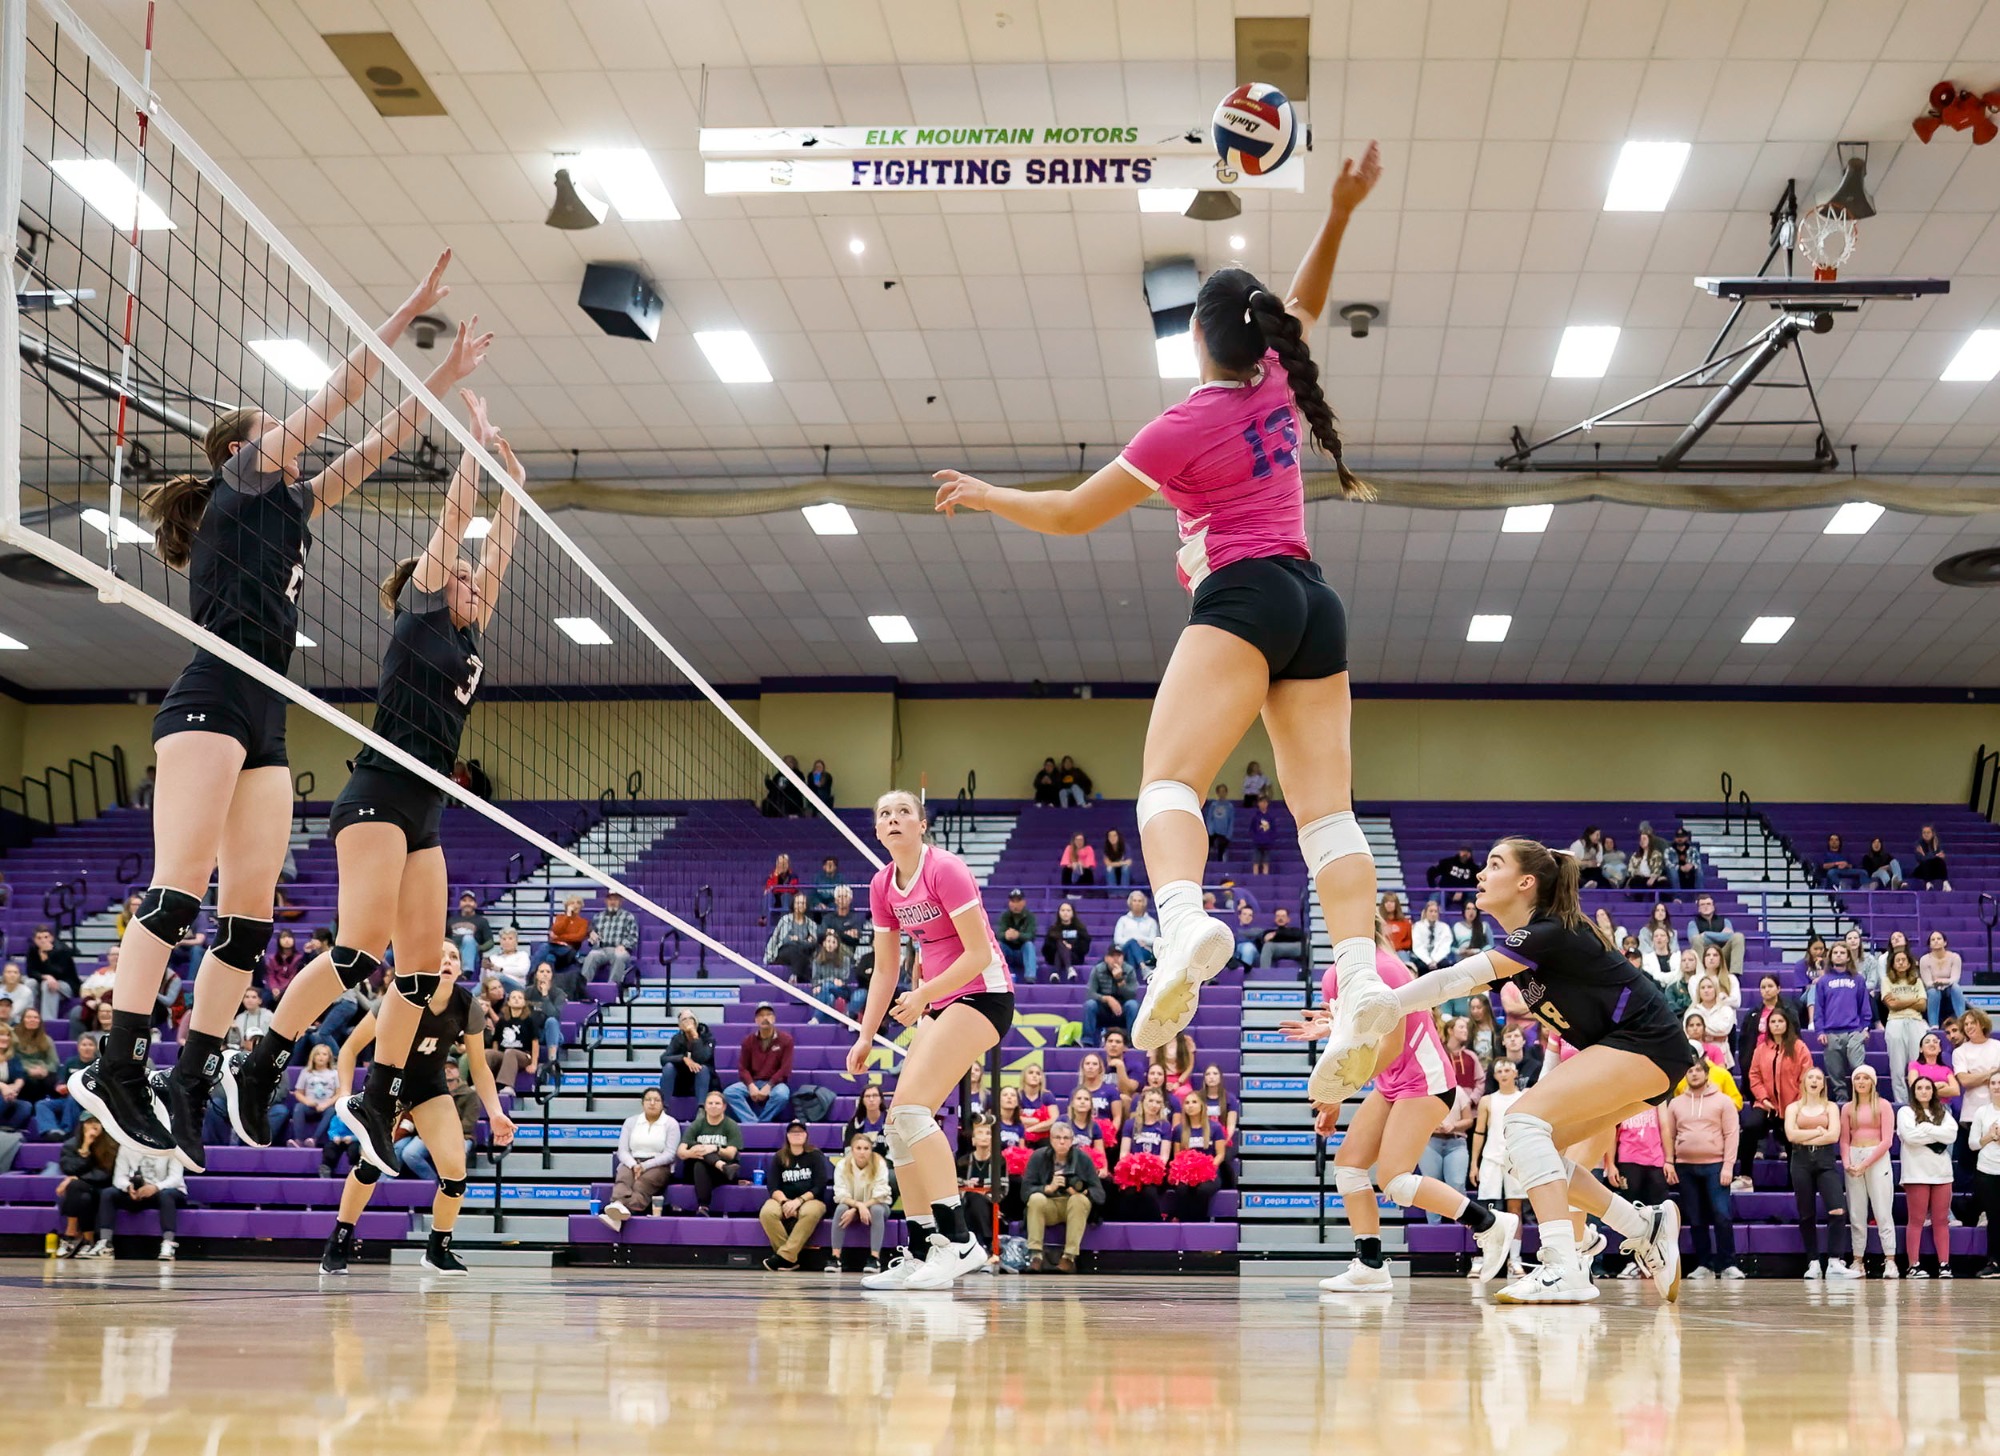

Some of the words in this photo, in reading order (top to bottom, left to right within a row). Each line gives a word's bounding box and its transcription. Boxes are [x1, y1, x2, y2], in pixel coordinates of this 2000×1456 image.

[865, 130, 908, 145] ELK
[915, 128, 1034, 145] MOUNTAIN
[1043, 127, 1139, 144] MOTORS
[851, 159, 1012, 185] FIGHTING
[1026, 158, 1151, 184] SAINTS
[454, 653, 484, 706] 3
[417, 1037, 439, 1055] 4
[1327, 1136, 1345, 1145] pep
[1264, 1196, 1288, 1207] pepsi
[1289, 1196, 1311, 1205] zone
